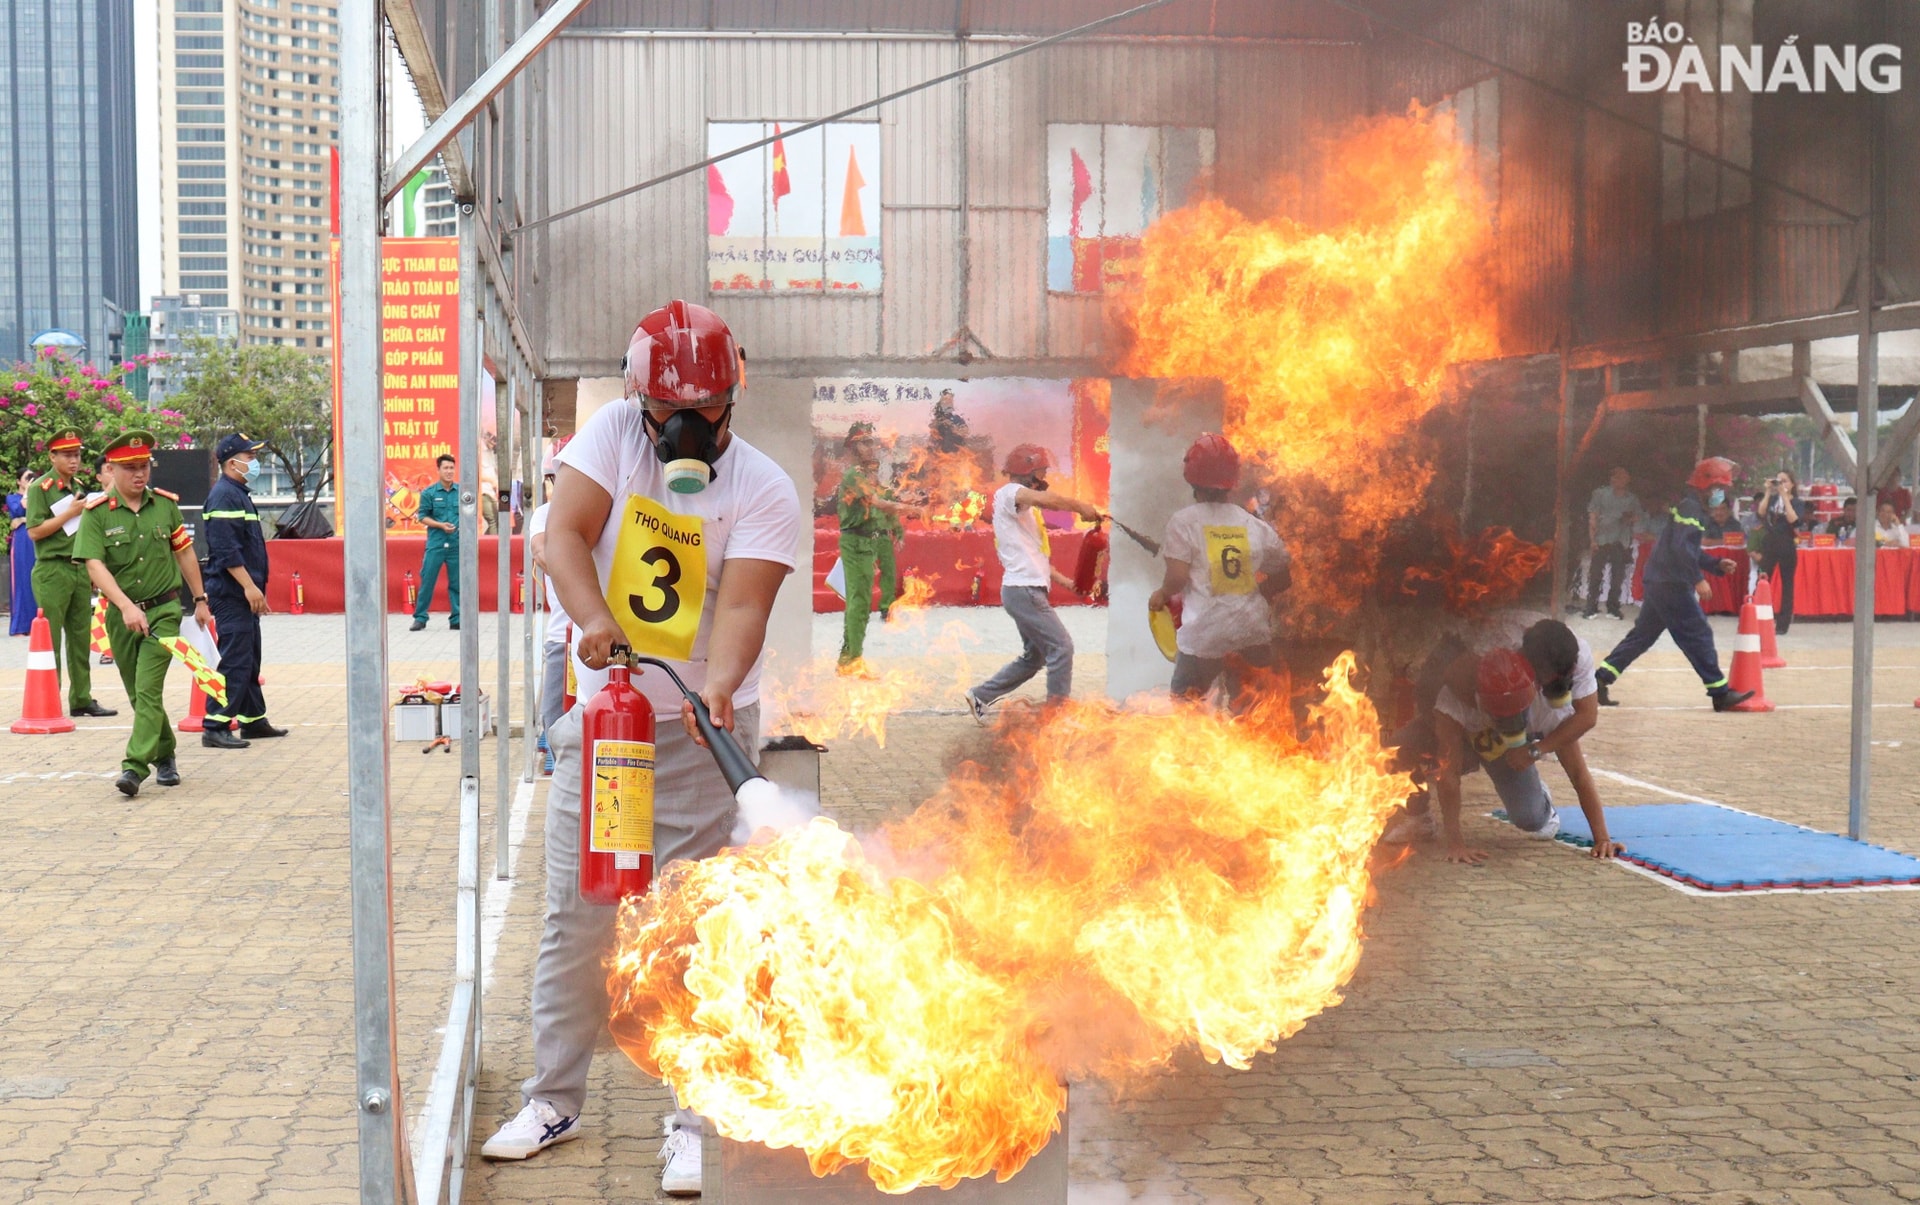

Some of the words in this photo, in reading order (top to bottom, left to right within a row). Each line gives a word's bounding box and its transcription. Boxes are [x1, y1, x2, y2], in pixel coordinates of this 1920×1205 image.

[403, 257, 436, 272] THAM
[438, 257, 458, 272] GIA
[382, 278, 410, 296] TRÀO
[412, 278, 443, 296] TOÀN
[445, 278, 459, 296] DÂ
[383, 301, 408, 319] ÒNG
[410, 301, 441, 319] CHÁY
[383, 325, 414, 343] CHỮA
[416, 325, 446, 342] CHÁY
[385, 348, 409, 366] GÓP
[383, 372, 408, 389] ỮNG
[410, 374, 427, 389] AN
[429, 374, 458, 389] NINH
[416, 398, 435, 416] TRỊ
[392, 419, 421, 439] TRẬT
[423, 420, 439, 439] TỰ
[385, 442, 410, 459] OÀN
[413, 442, 430, 459] XÃ
[635, 511, 660, 533] THỌ
[661, 522, 701, 546] QUANG
[1221, 545, 1242, 580] 6
[629, 546, 682, 623] 3
